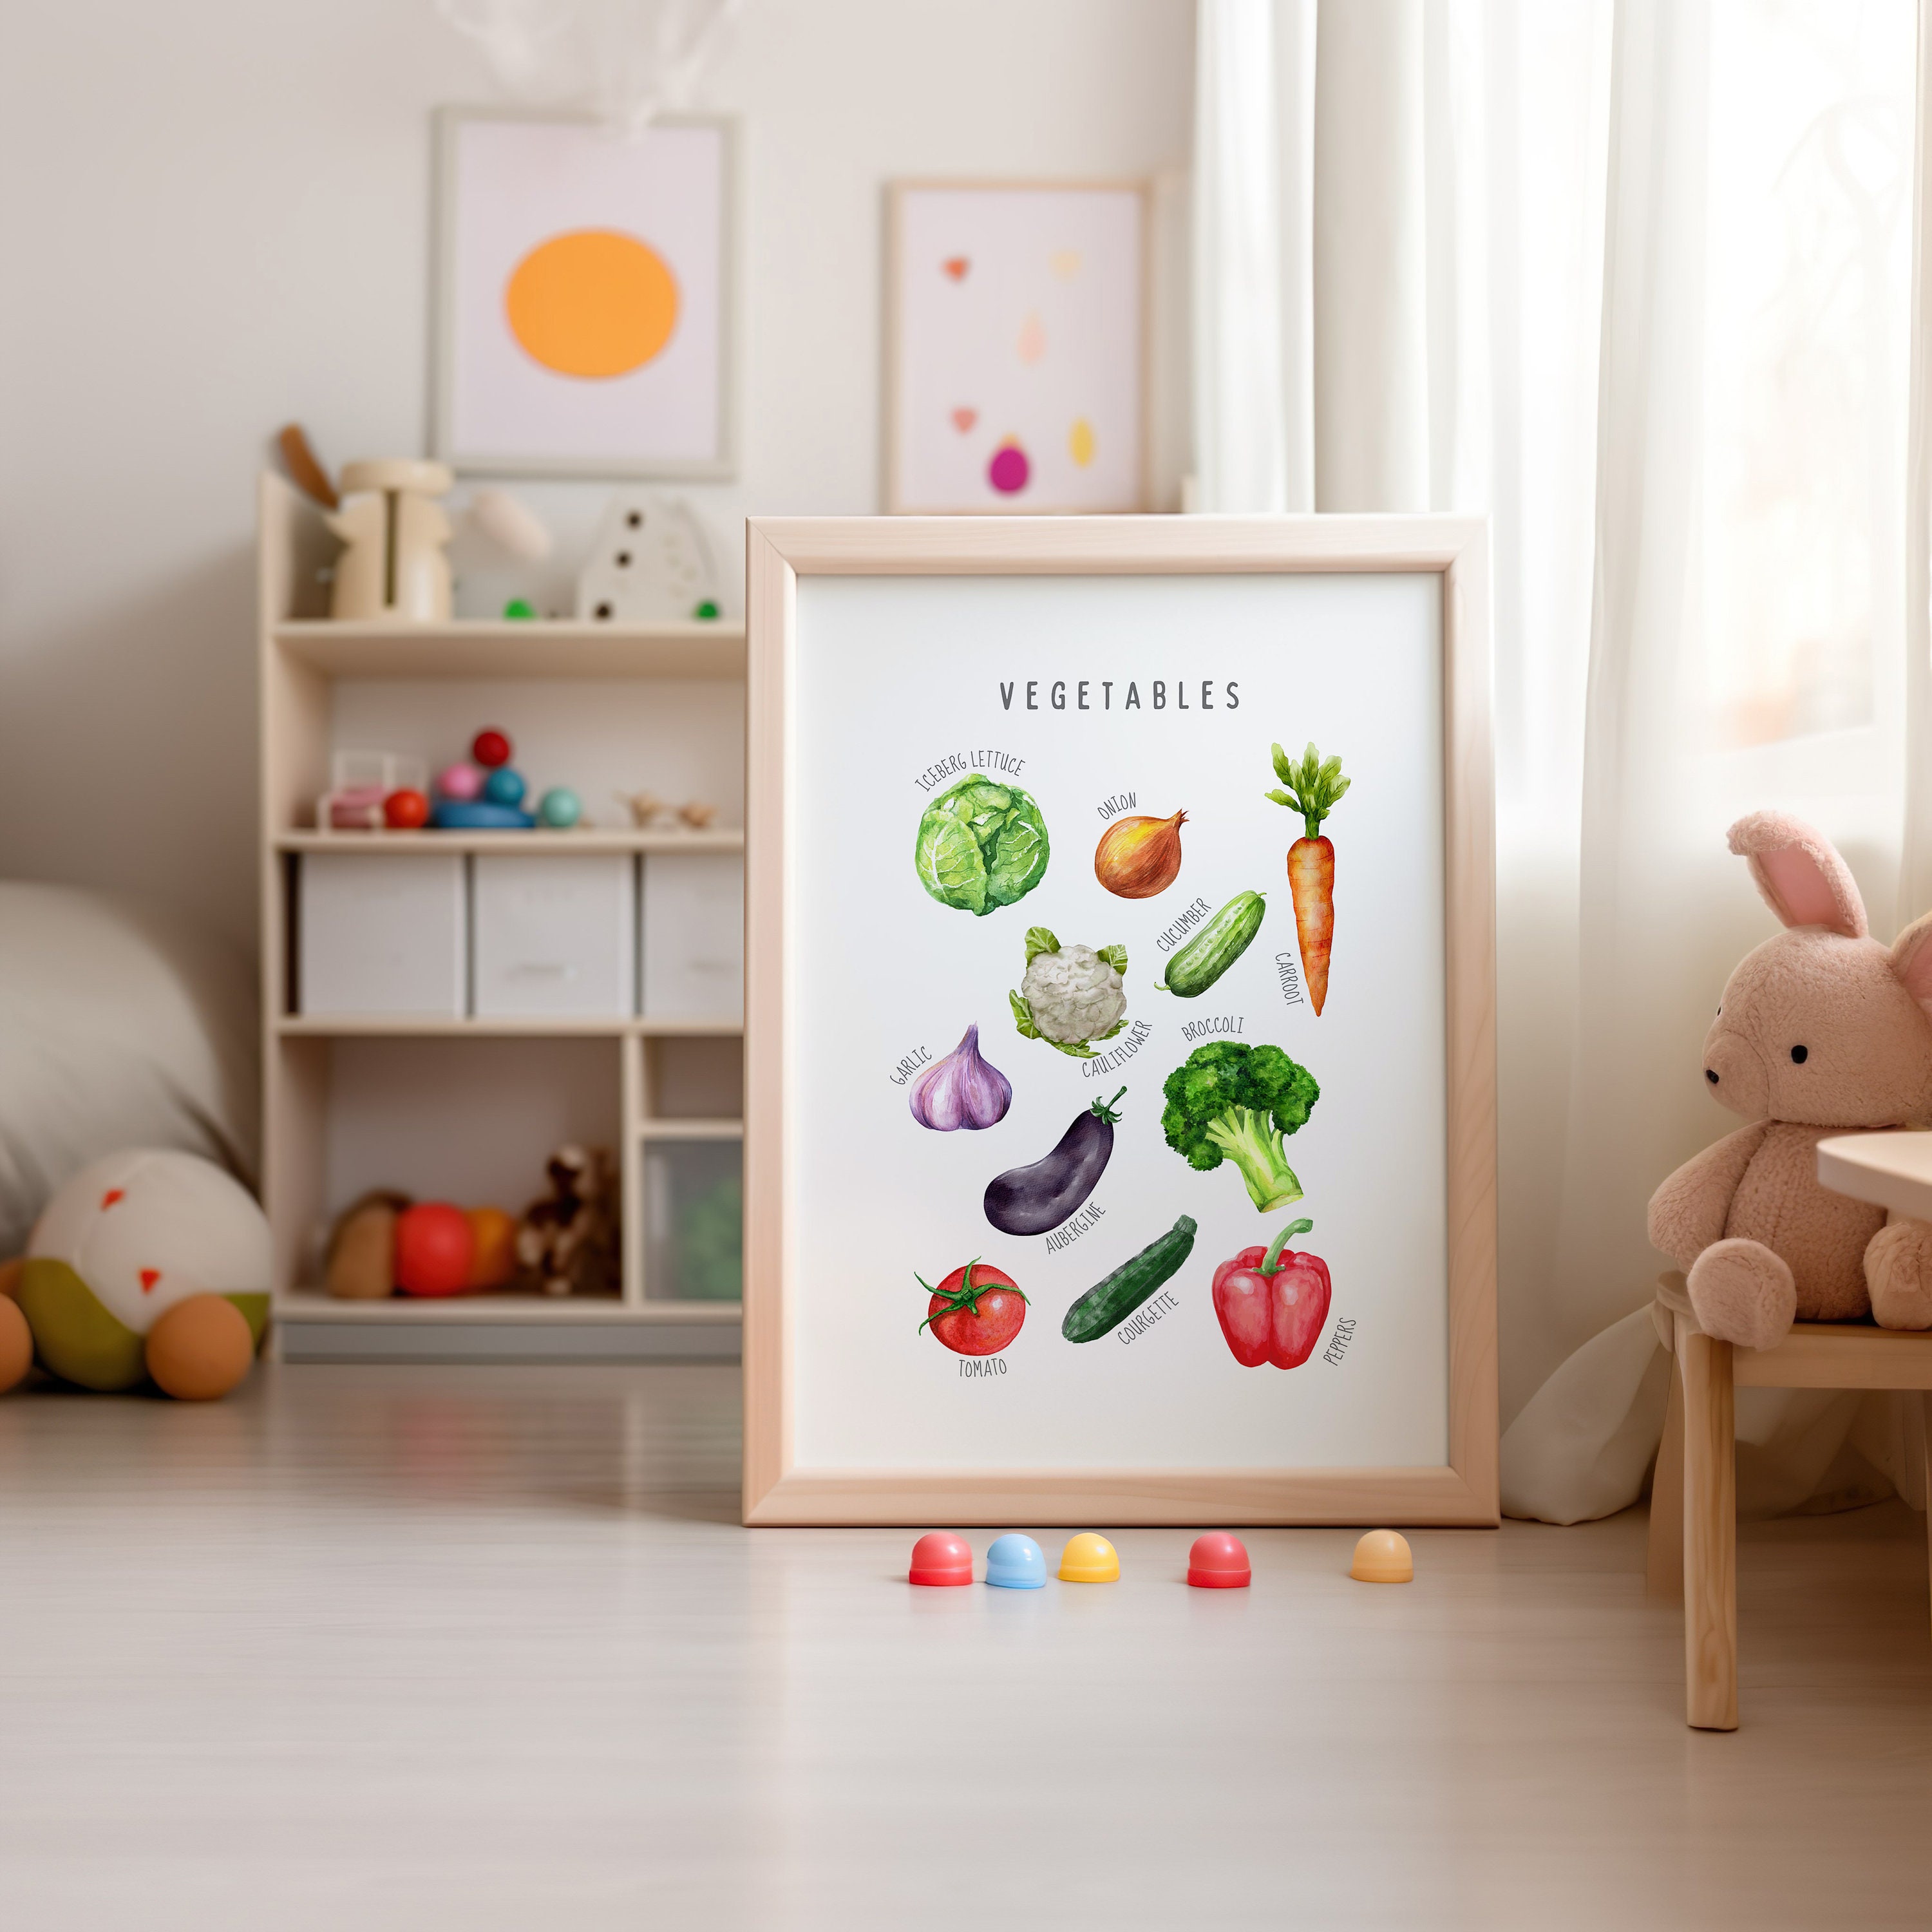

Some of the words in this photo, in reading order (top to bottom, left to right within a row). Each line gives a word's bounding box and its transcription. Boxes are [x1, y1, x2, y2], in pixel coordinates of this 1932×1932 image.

[999, 680, 1239, 710] VEGETABLES
[914, 753, 967, 792] ICEBERG
[971, 750, 1026, 777] LETTUCE
[1097, 791, 1136, 820] ONION
[1157, 898, 1211, 952] CUCUMBER
[1275, 952, 1304, 1005] CARROOT
[1082, 1020, 1153, 1077] CAULIFLOWER
[1181, 1016, 1244, 1042] BROCCOLI
[889, 1045, 932, 1085] GARLIC
[1046, 1201, 1106, 1255] AUBERGINE
[1117, 1291, 1180, 1345] COURGETTE
[1323, 1317, 1357, 1367] PEPPERS
[958, 1358, 1007, 1378] TOMATO
